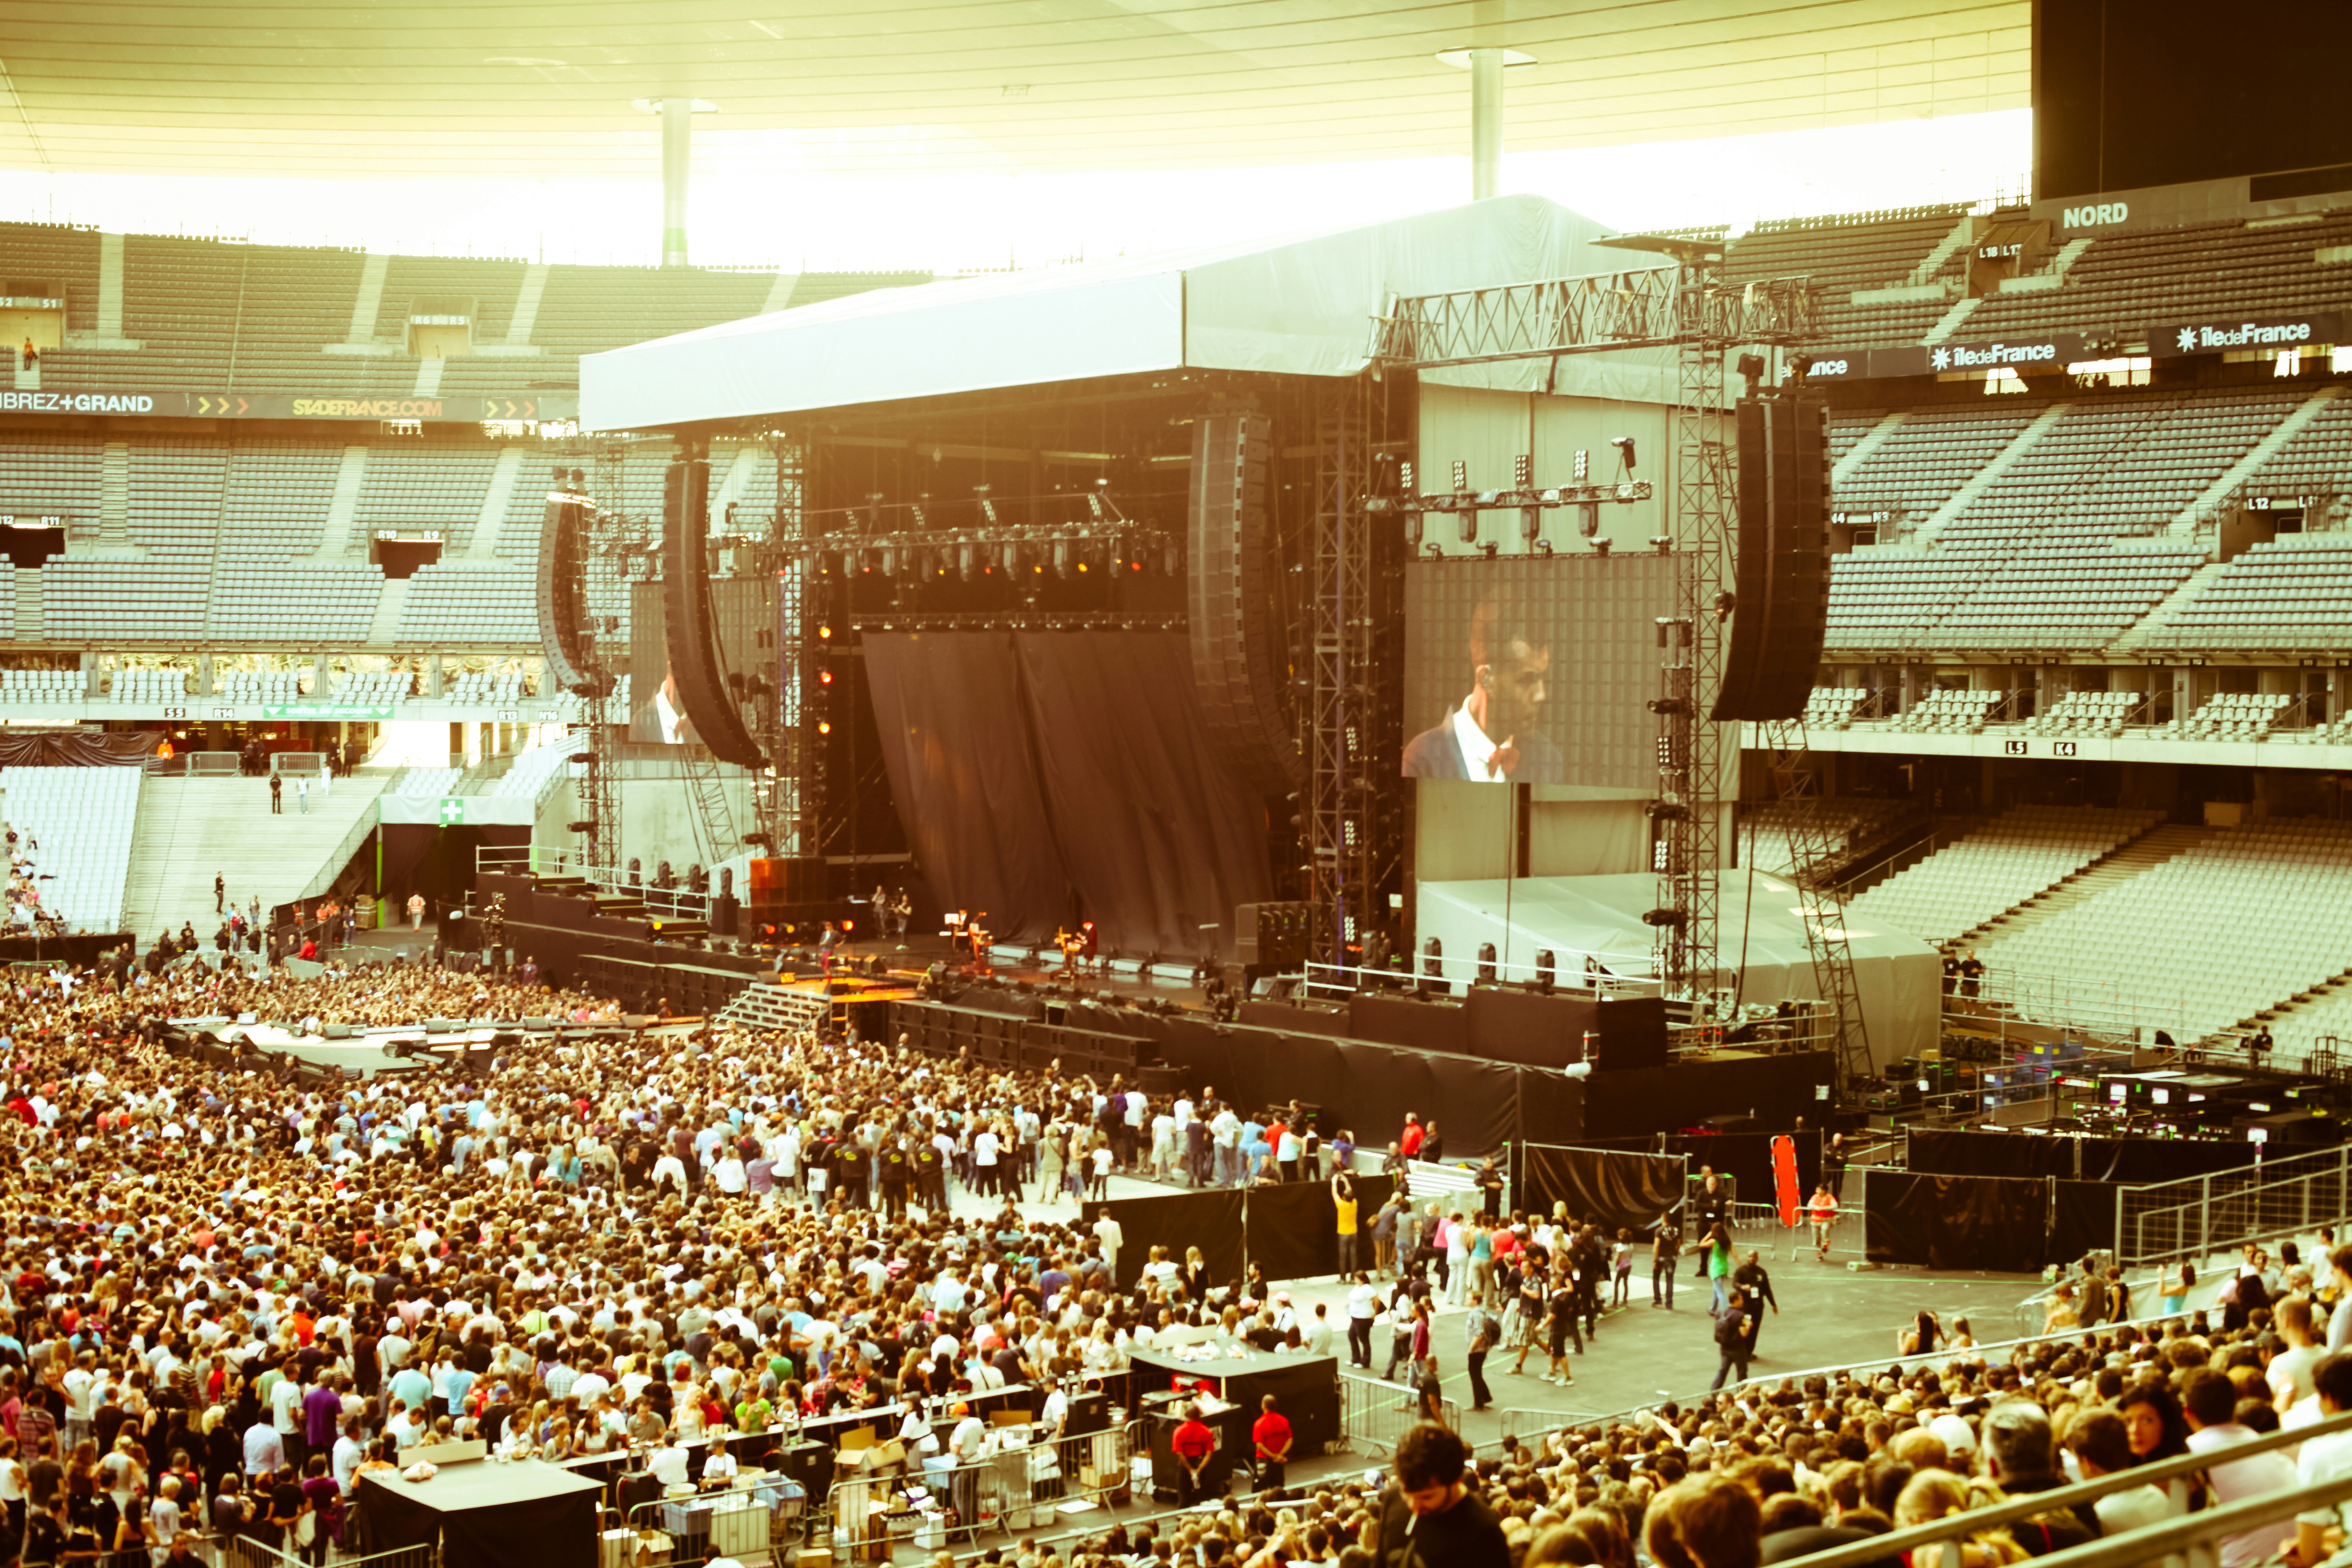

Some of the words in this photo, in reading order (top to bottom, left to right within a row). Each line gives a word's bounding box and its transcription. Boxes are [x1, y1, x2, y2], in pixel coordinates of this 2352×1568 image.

[2063, 202, 2128, 228] NORD
[1979, 246, 1998, 258] L18
[42, 299, 57, 308] S1
[415, 316, 430, 325] R6
[449, 316, 465, 325] R5
[293, 400, 443, 416] STADEFRANCE.COM
[2248, 497, 2269, 510] L12
[0, 515, 14, 525] 12
[41, 516, 60, 525] R11
[1873, 511, 1888, 522] N3
[378, 530, 397, 539] R10
[423, 530, 439, 539] R9
[214, 709, 234, 718] R14
[498, 711, 518, 720] R13
[539, 711, 558, 720] N16
[2008, 742, 2024, 754] L5
[2055, 743, 2073, 755] K4
